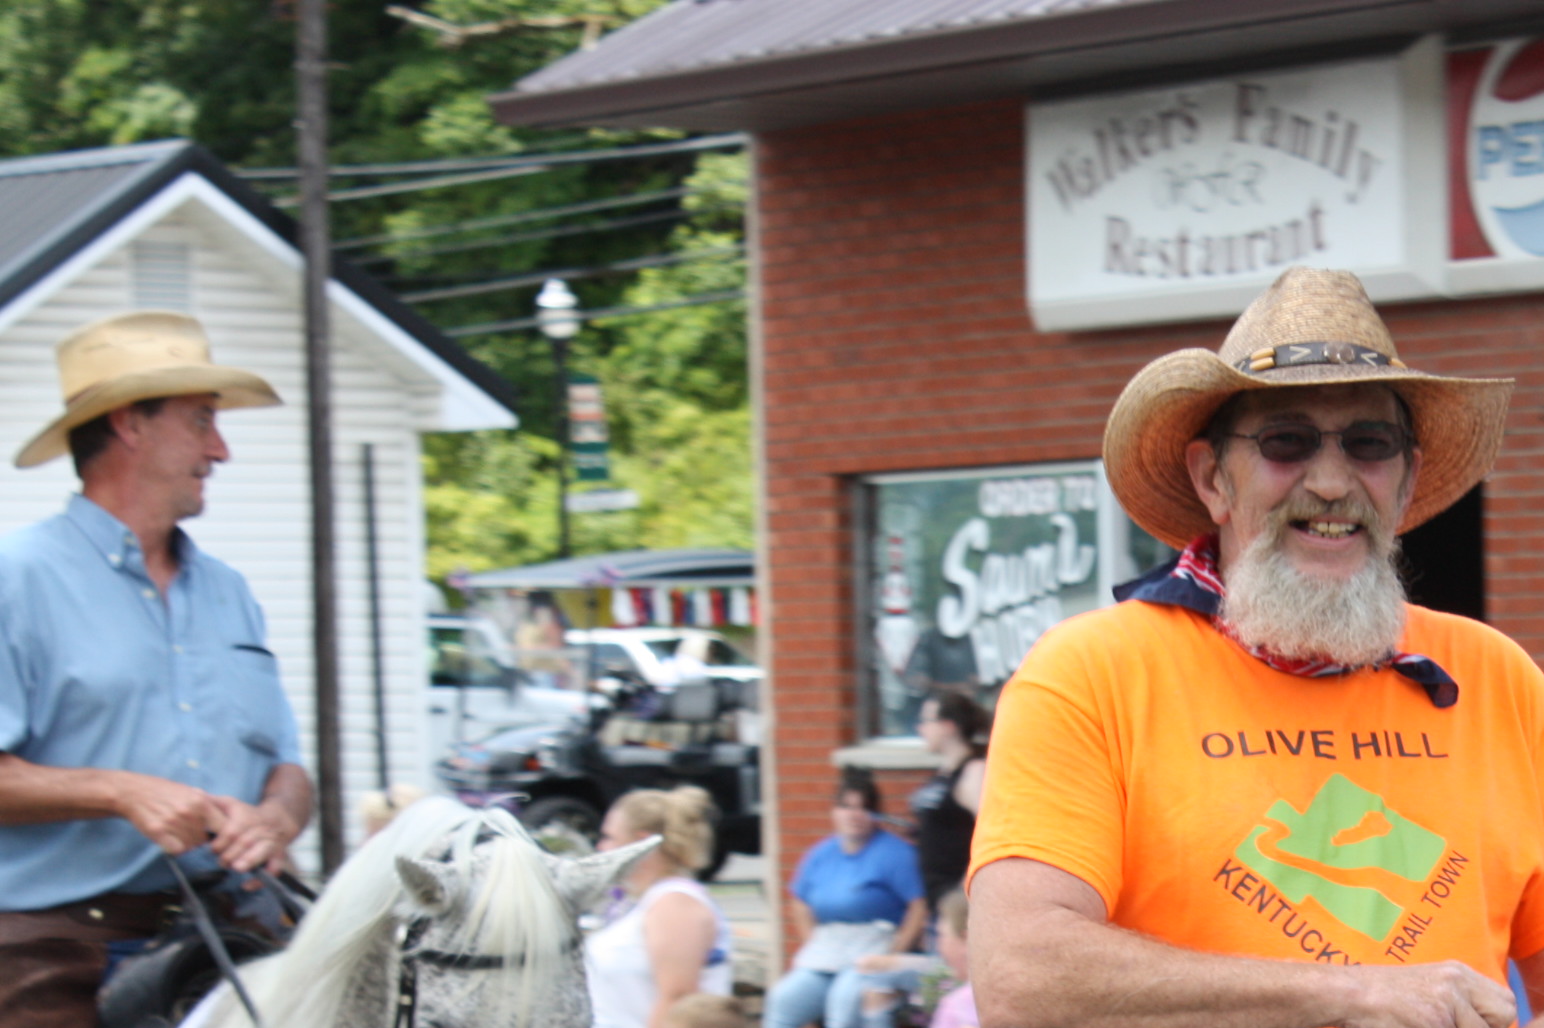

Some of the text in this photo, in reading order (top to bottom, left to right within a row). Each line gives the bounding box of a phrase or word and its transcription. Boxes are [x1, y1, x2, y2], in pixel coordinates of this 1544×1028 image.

[1103, 199, 1329, 279] Restaurant
[1201, 730, 1449, 760] OLIVE HILL
[1384, 912, 1434, 963] TRAIL
[1420, 850, 1470, 908] TOWN
